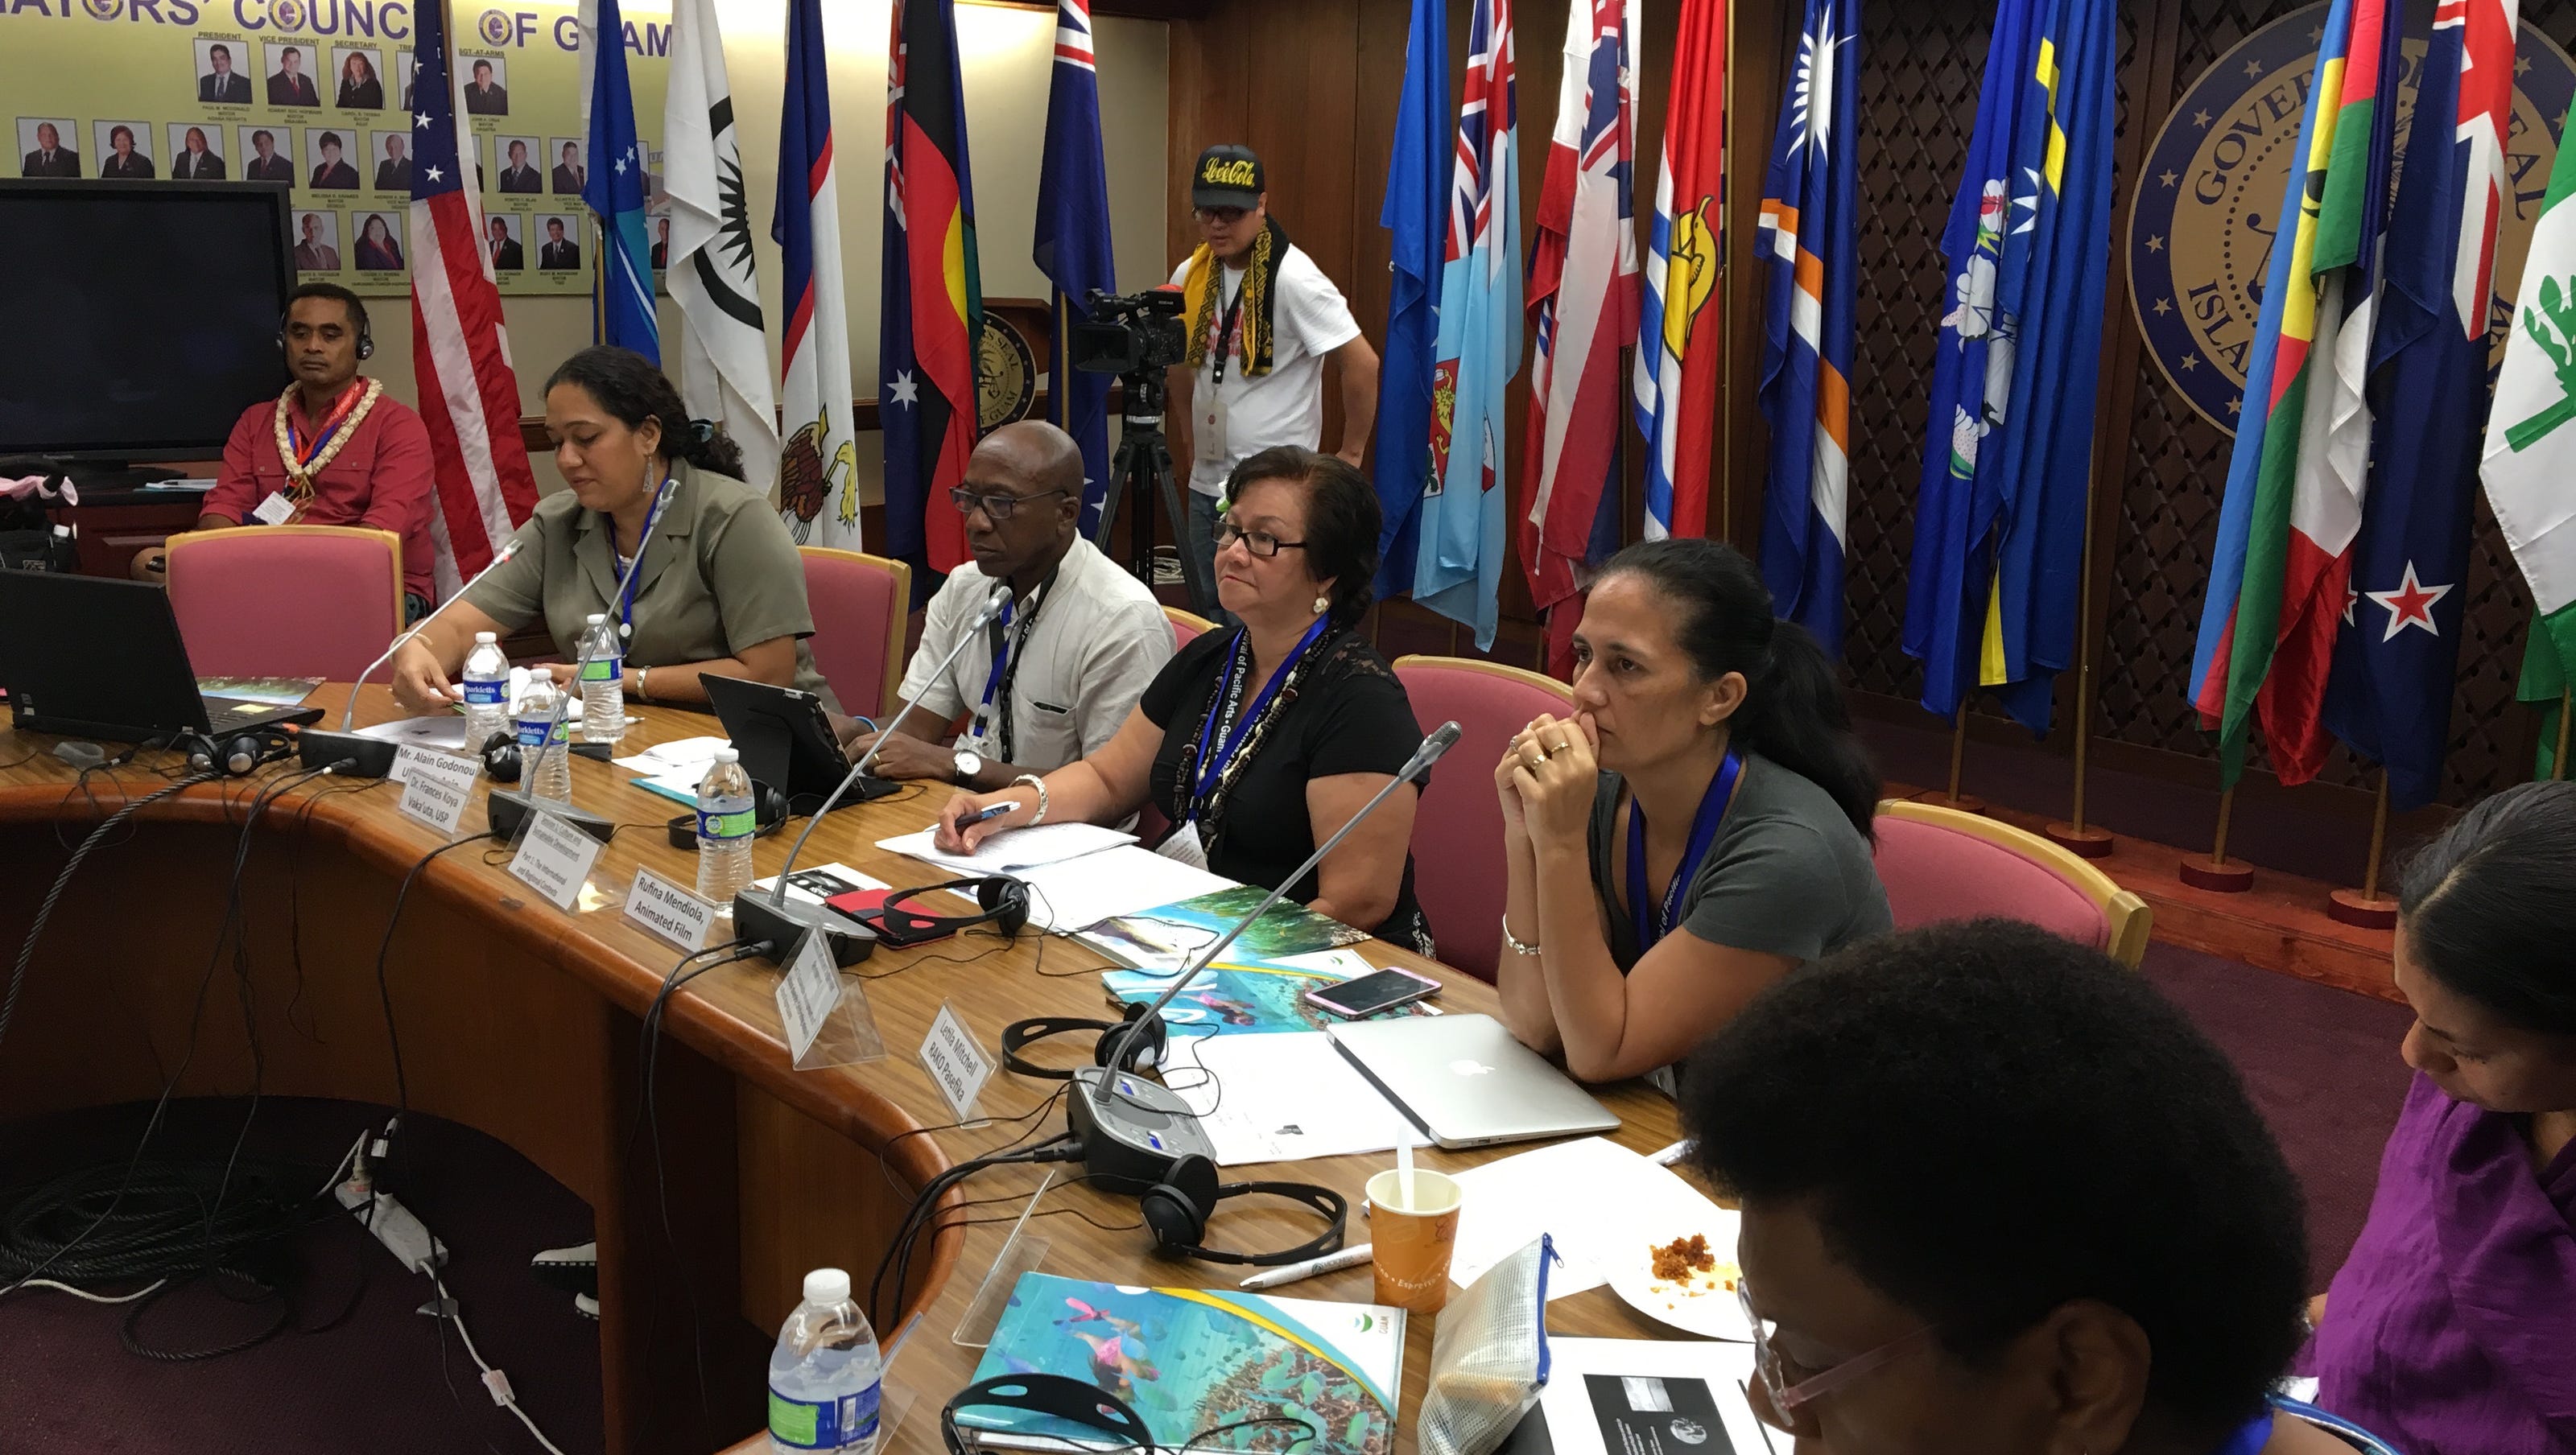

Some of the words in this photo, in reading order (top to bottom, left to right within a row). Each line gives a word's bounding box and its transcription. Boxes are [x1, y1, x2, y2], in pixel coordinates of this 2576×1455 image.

[198, 31, 242, 40] PRESIDENT
[258, 35, 275, 43] VICE
[278, 36, 320, 45] PRESIDENT
[334, 39, 378, 49] SECRETARY
[554, 15, 672, 58] GAM
[1237, 655, 1248, 668] of
[1230, 667, 1246, 699] Pacific
[1224, 699, 1239, 722] Arts
[398, 748, 411, 760] Mr.
[414, 752, 435, 766] Alain
[436, 757, 476, 776] Godonou
[411, 777, 419, 788] Dr.
[420, 781, 442, 800] Frances
[443, 791, 459, 808] Koya
[436, 809, 450, 824] USP
[522, 851, 531, 863] Part
[542, 864, 568, 885] International
[638, 876, 663, 900] Rufina
[663, 891, 704, 925] Mendiola,
[634, 901, 675, 931] Animated
[674, 921, 693, 942] Film
[928, 1041, 945, 1070] RAKO
[941, 1061, 965, 1103] Pasefika
[953, 1037, 979, 1078] Mitchell
[1397, 1277, 1437, 1291] Espresso
